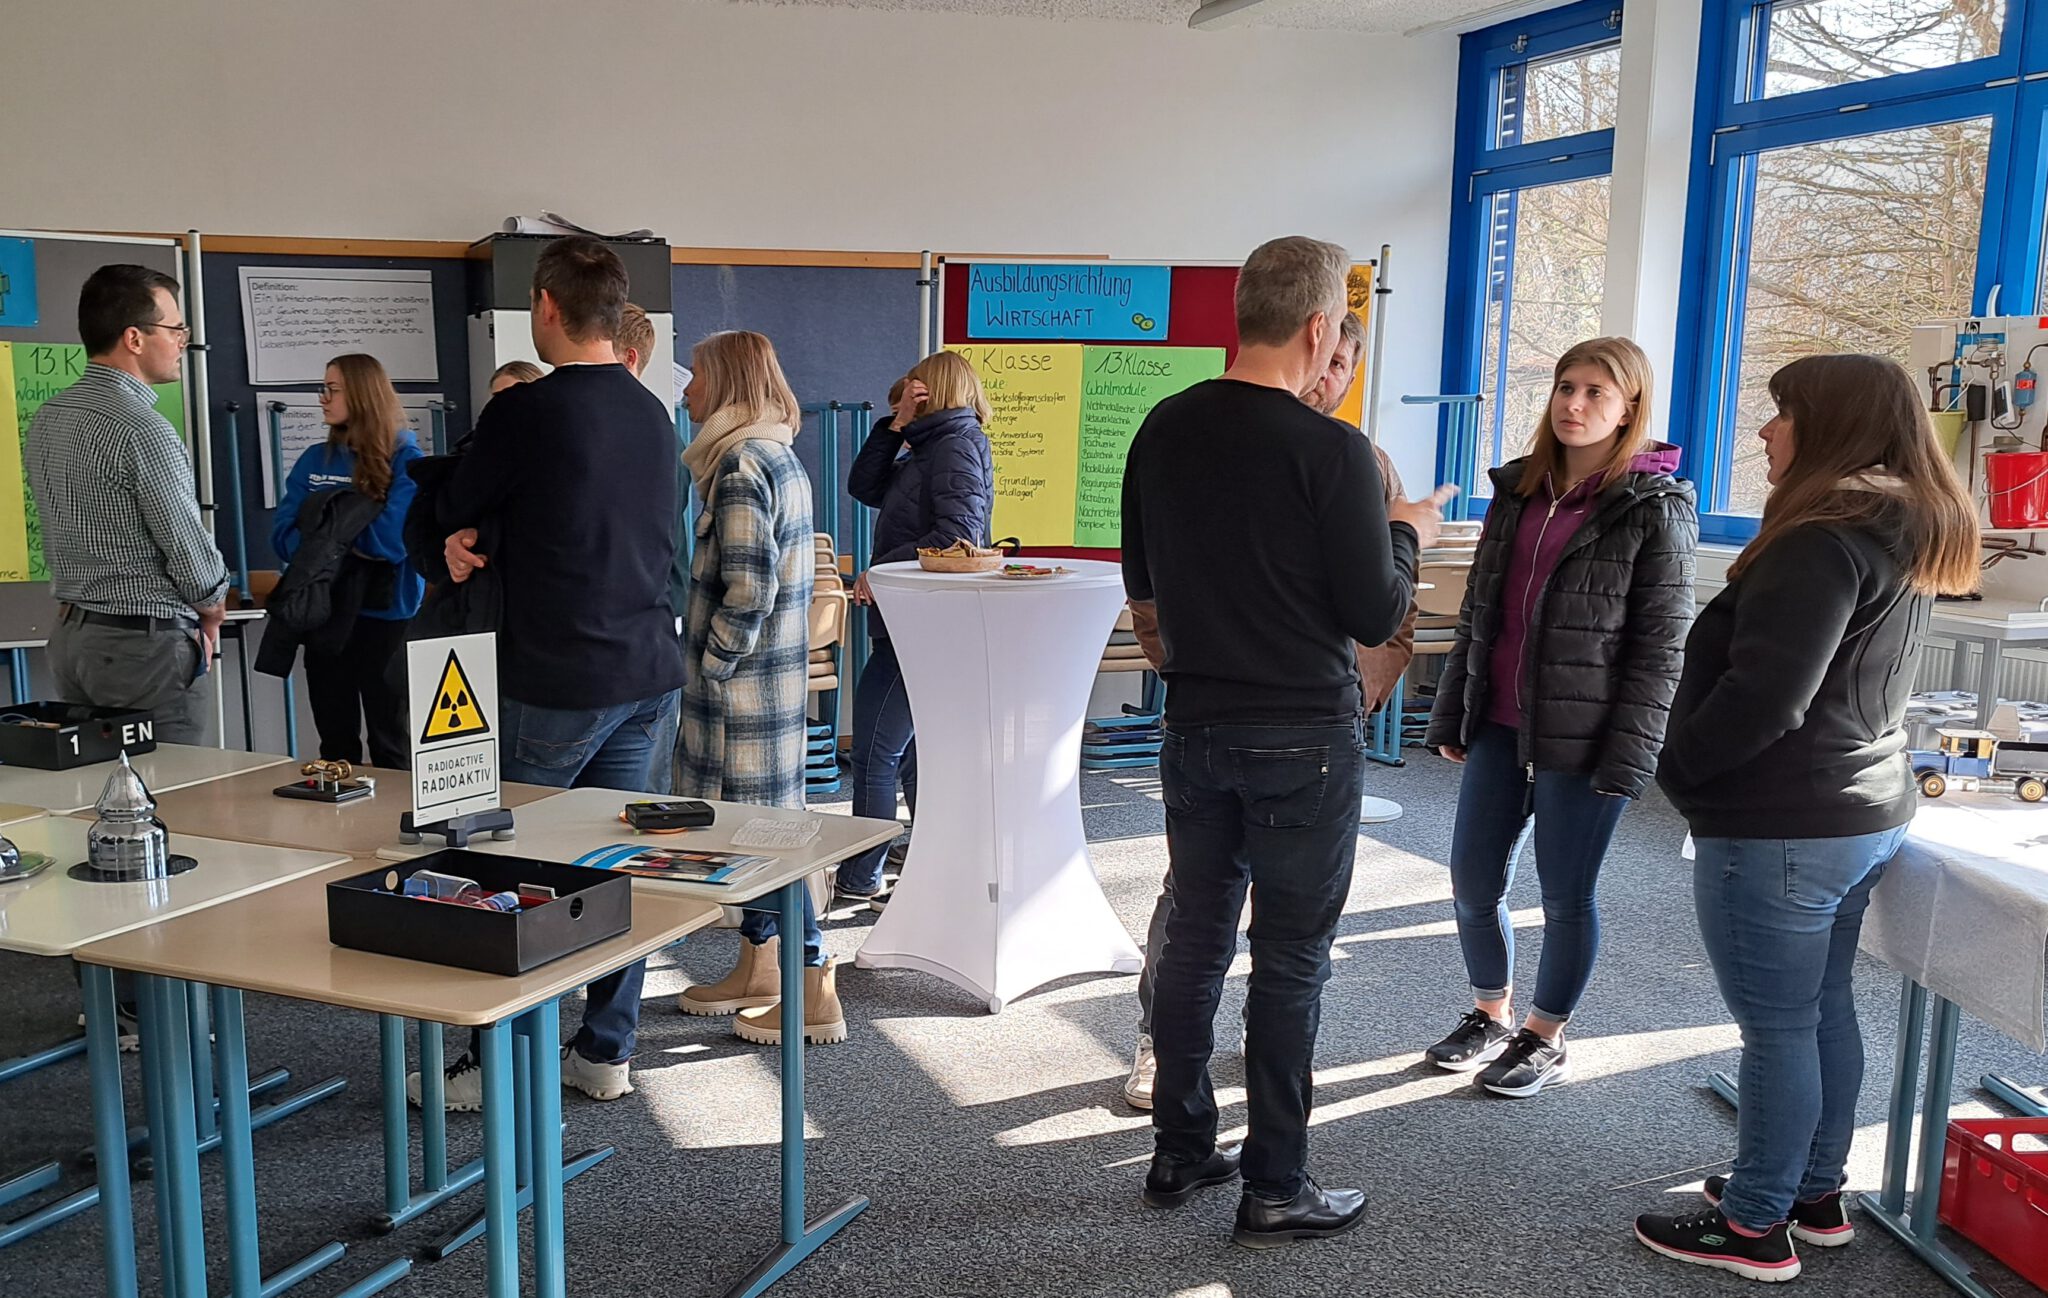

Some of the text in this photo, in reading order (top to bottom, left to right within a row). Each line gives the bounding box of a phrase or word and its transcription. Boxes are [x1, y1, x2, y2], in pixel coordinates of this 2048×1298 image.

[252, 282, 299, 291] Definition:
[971, 267, 1132, 307] Ausbildungsrichtung
[986, 300, 1095, 328] WIRTSCHAFT
[65, 347, 84, 377] K
[982, 347, 1053, 374] Klasse
[1081, 461, 1124, 474] Modellbildun
[994, 488, 1034, 501] rundlagen
[998, 475, 1046, 491] Grundlagen
[70, 720, 154, 755] 1 EN
[428, 753, 485, 774] RADIOACTIVE
[421, 767, 492, 795] RADIOAKTIV
